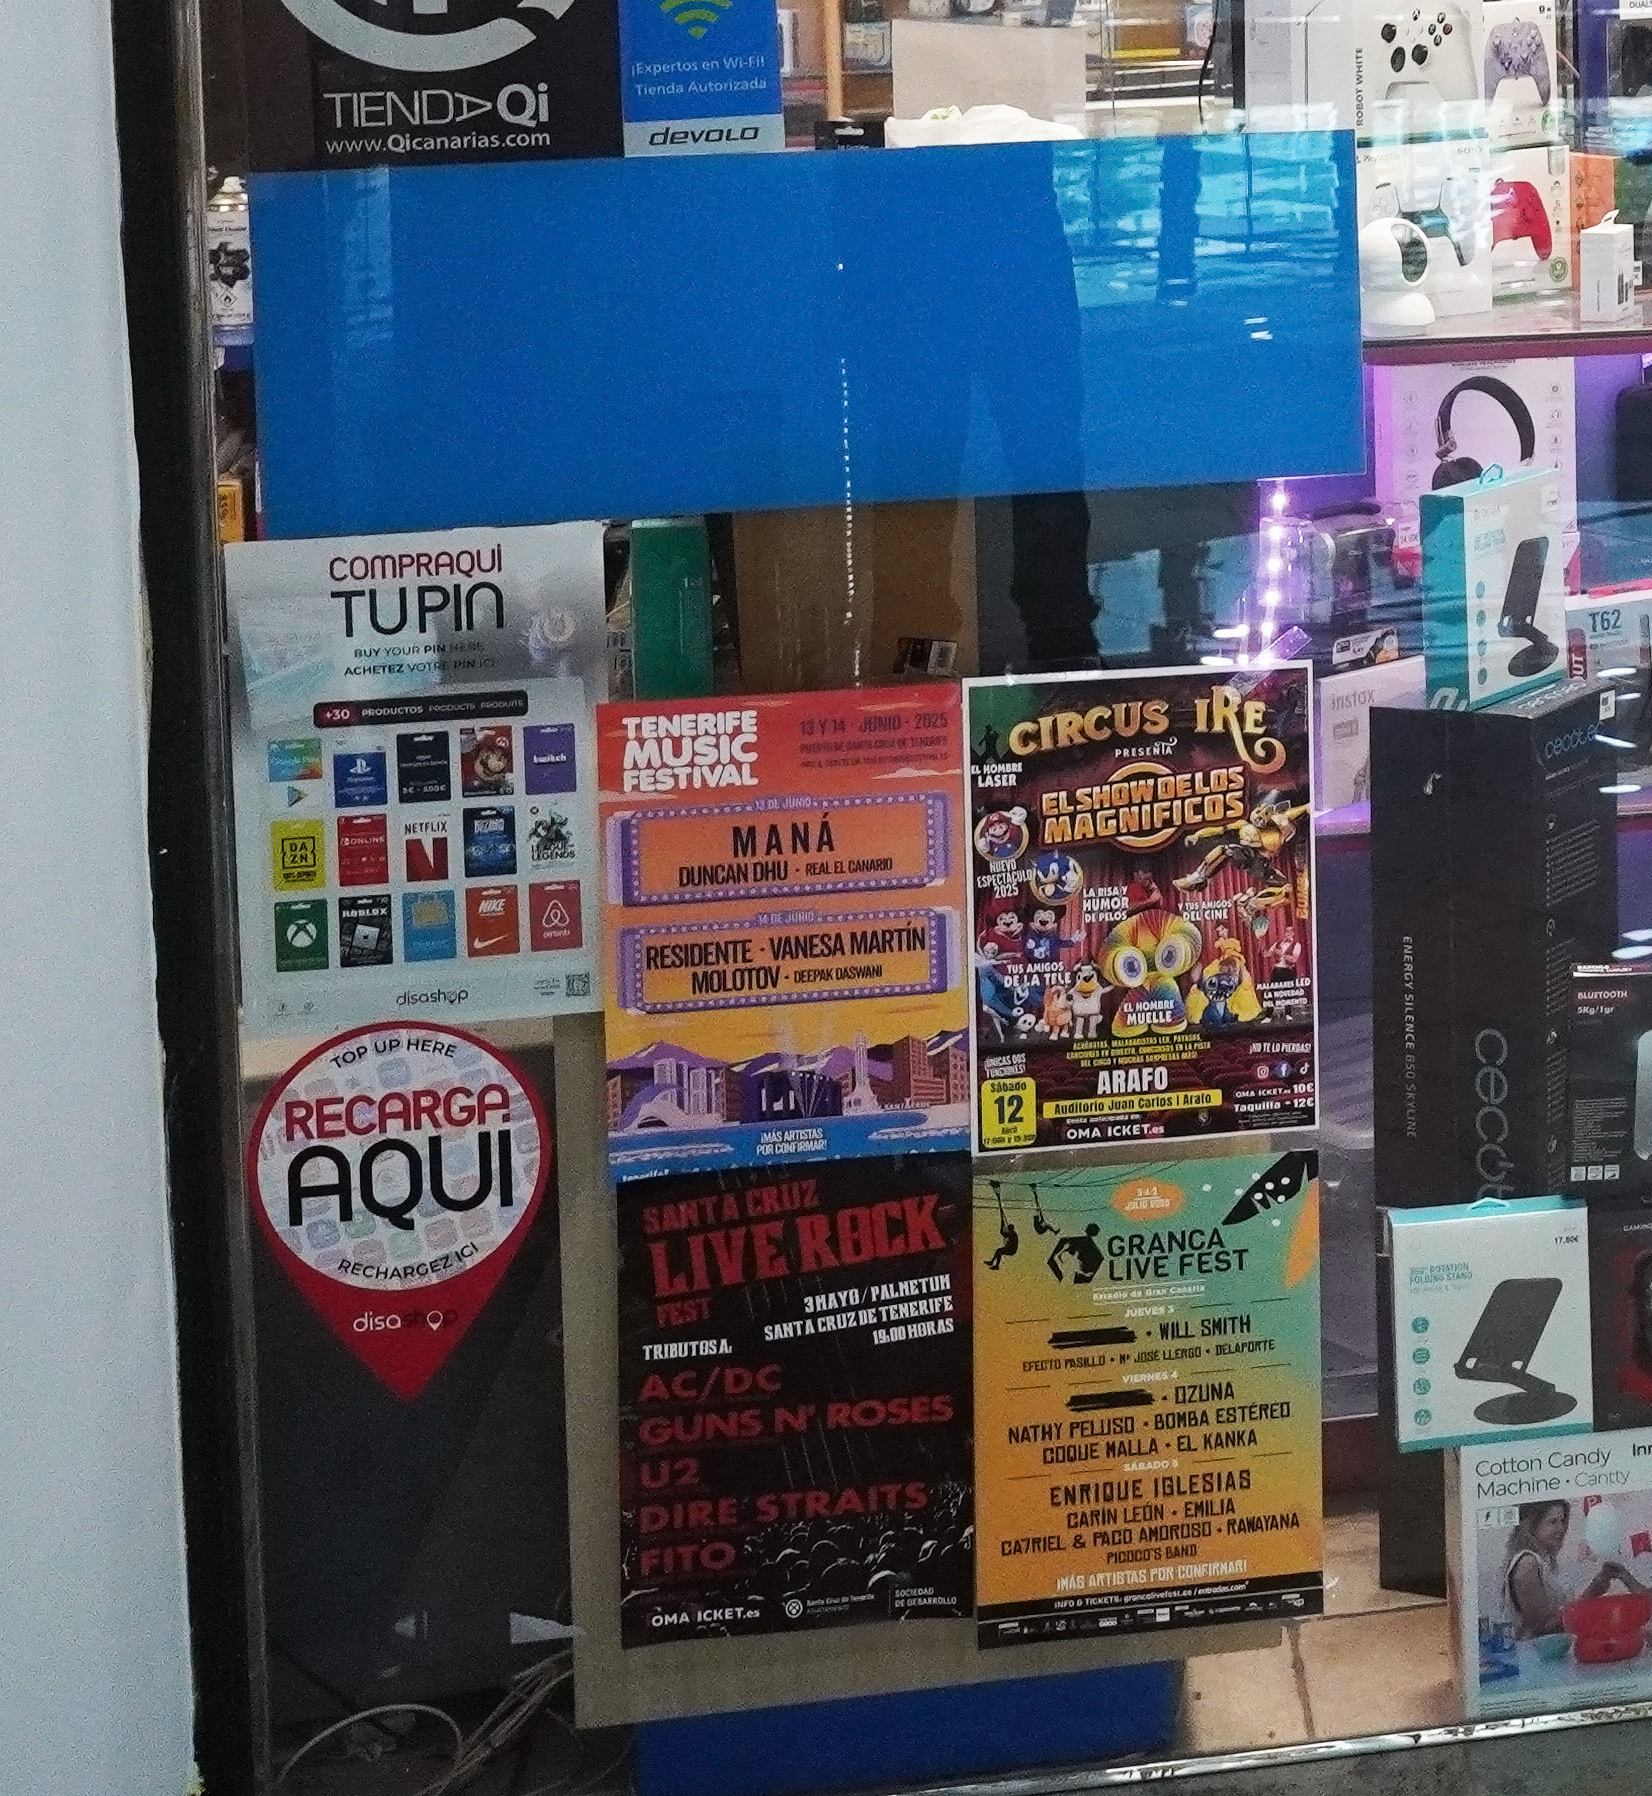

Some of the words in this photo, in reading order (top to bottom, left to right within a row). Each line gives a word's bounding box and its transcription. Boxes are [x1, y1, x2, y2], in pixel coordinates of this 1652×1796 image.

[631, 58, 697, 78] ¡Expertos
[703, 57, 720, 72] en
[725, 55, 765, 71] Wi-Fi!
[635, 80, 682, 97] Tienda
[688, 76, 766, 95] Autorizada
[324, 86, 491, 128] TIENDA
[497, 83, 549, 126] Qi
[326, 130, 551, 154] www.Qicanarias.com
[649, 126, 759, 145] devolo
[332, 589, 412, 638] TU
[418, 581, 504, 635] PIN
[623, 710, 758, 738] TENERIFE
[1009, 700, 1169, 756] CIRCUS
[623, 735, 758, 769] MUSIC
[624, 762, 758, 793] FESTIVAL
[404, 823, 448, 836] NETFLIX
[732, 813, 835, 857] MANÁ
[647, 938, 753, 971] RESIDENTE
[770, 932, 845, 962] VANESA
[850, 920, 926, 954] MARTÍN
[329, 1046, 365, 1070] TOP
[374, 1038, 400, 1058] UP
[406, 1038, 457, 1061] HERE
[1097, 1068, 1168, 1095] ARAFO
[286, 1087, 510, 1141] RECARGA
[650, 1223, 791, 1297] LIVE
[797, 1192, 946, 1273] ROCK
[1107, 1230, 1225, 1258] GRANCA
[1107, 1254, 1173, 1282] LIVE
[1177, 1248, 1249, 1275] FEST
[1158, 1319, 1195, 1342] WILL
[1201, 1315, 1251, 1339] SMITH
[639, 1363, 782, 1401] AC/DC
[1477, 1454, 1541, 1477] Cotton
[1548, 1448, 1611, 1473] Candy
[1050, 1477, 1148, 1508] ENRIQUE
[1154, 1470, 1251, 1500] IGLESIAS
[1478, 1474, 1560, 1499] Machine
